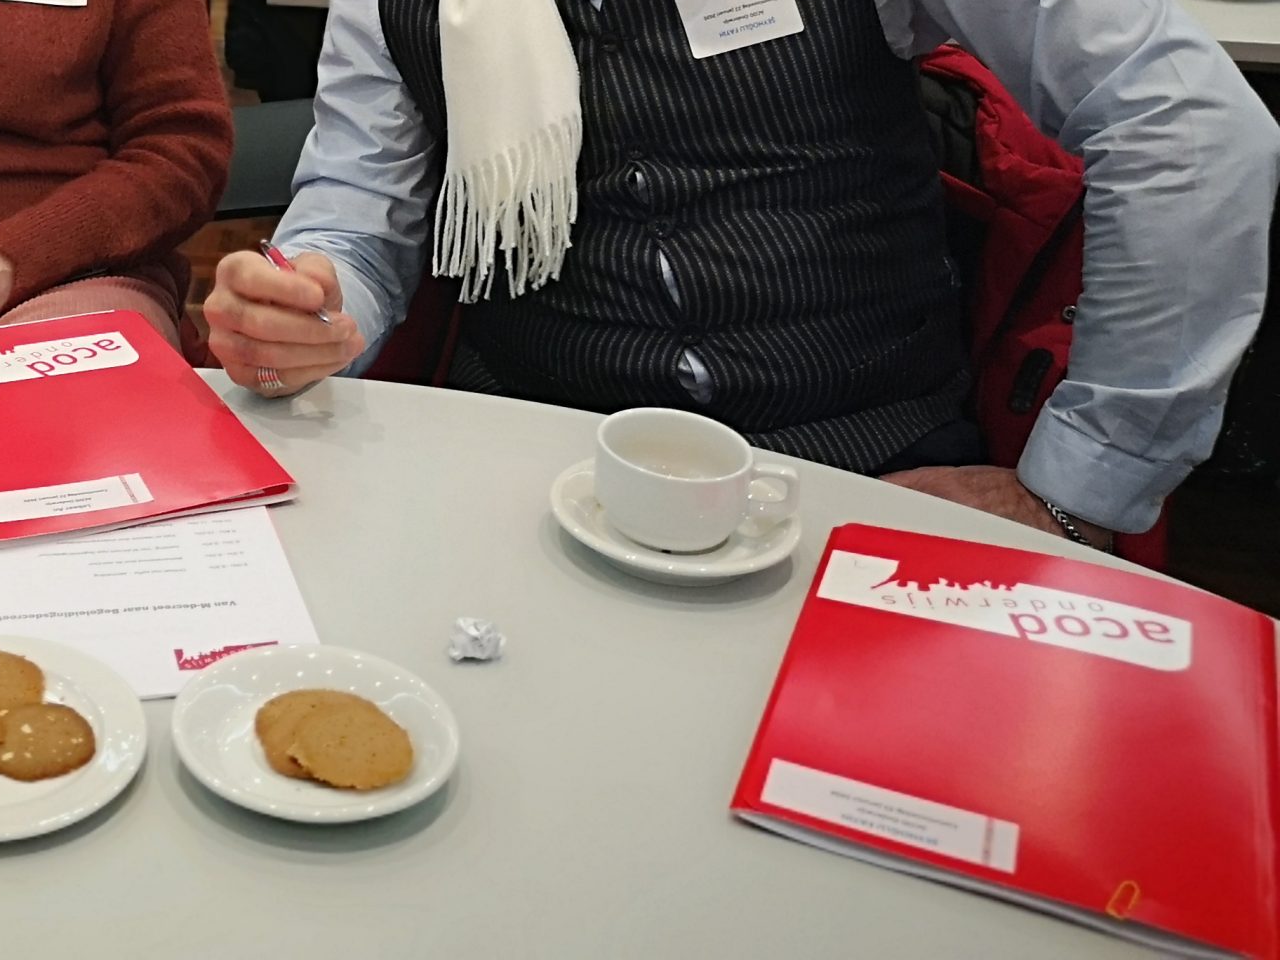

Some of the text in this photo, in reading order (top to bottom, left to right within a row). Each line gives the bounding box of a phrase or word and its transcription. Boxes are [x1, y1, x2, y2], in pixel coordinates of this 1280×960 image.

[26, 338, 122, 377] acod
[122, 605, 149, 613] naar
[213, 600, 237, 608] Van
[881, 593, 1105, 613] onderwijs
[1009, 612, 1175, 644] acod
